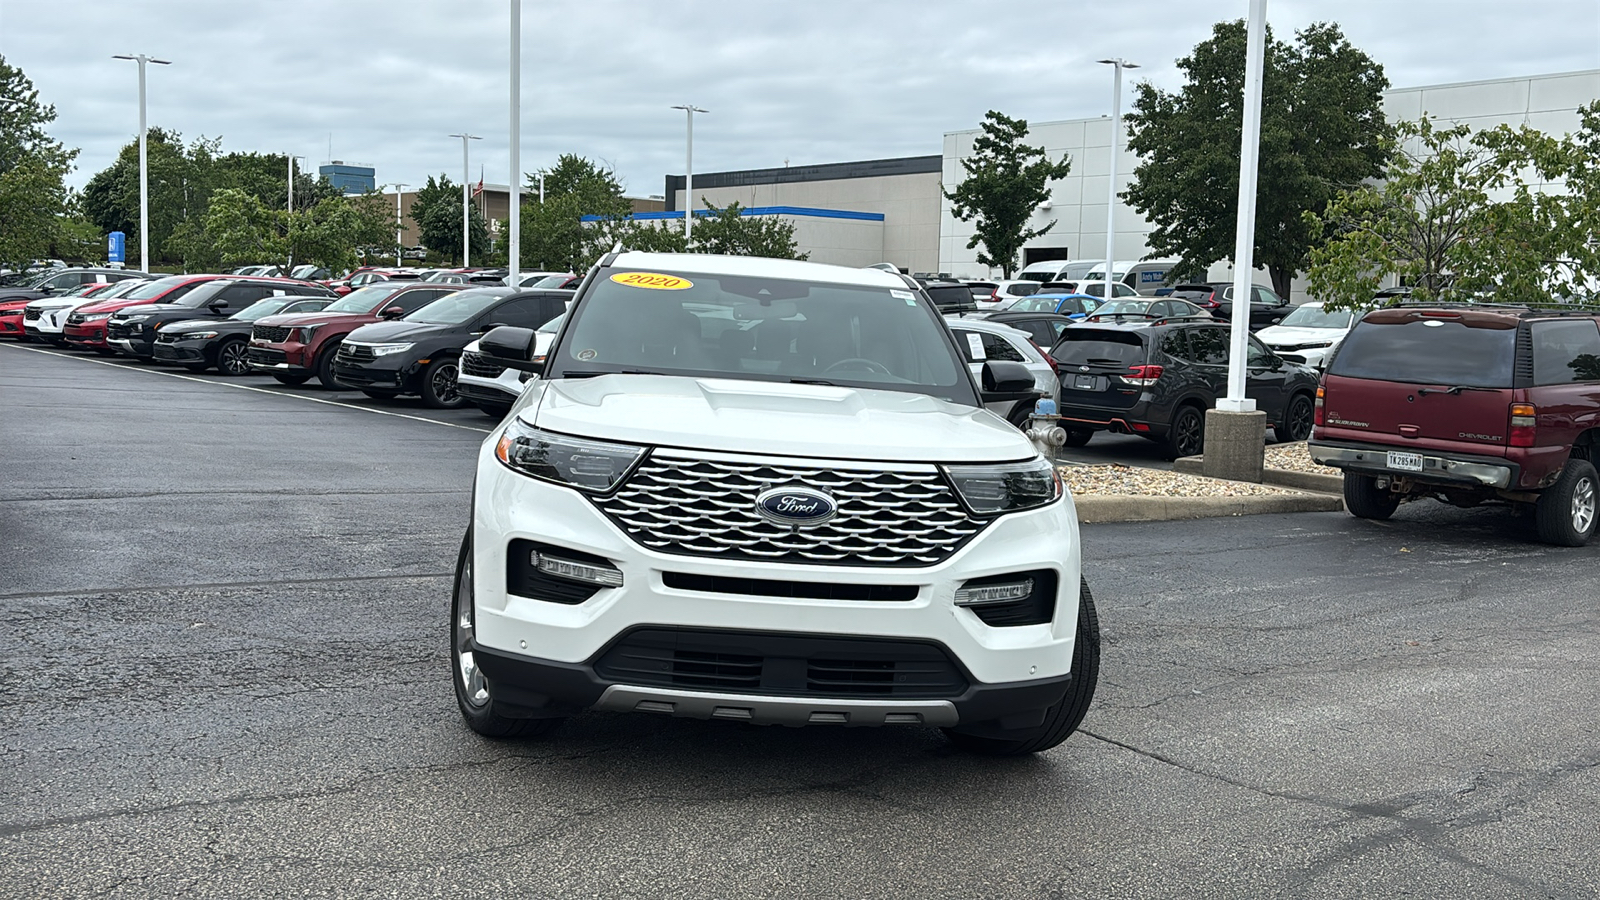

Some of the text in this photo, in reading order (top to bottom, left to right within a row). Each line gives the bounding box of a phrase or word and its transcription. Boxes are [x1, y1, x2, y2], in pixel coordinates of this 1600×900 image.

[622, 274, 680, 287] 2020
[1458, 432, 1502, 441] CHEVROLET
[776, 495, 819, 514] Ford
